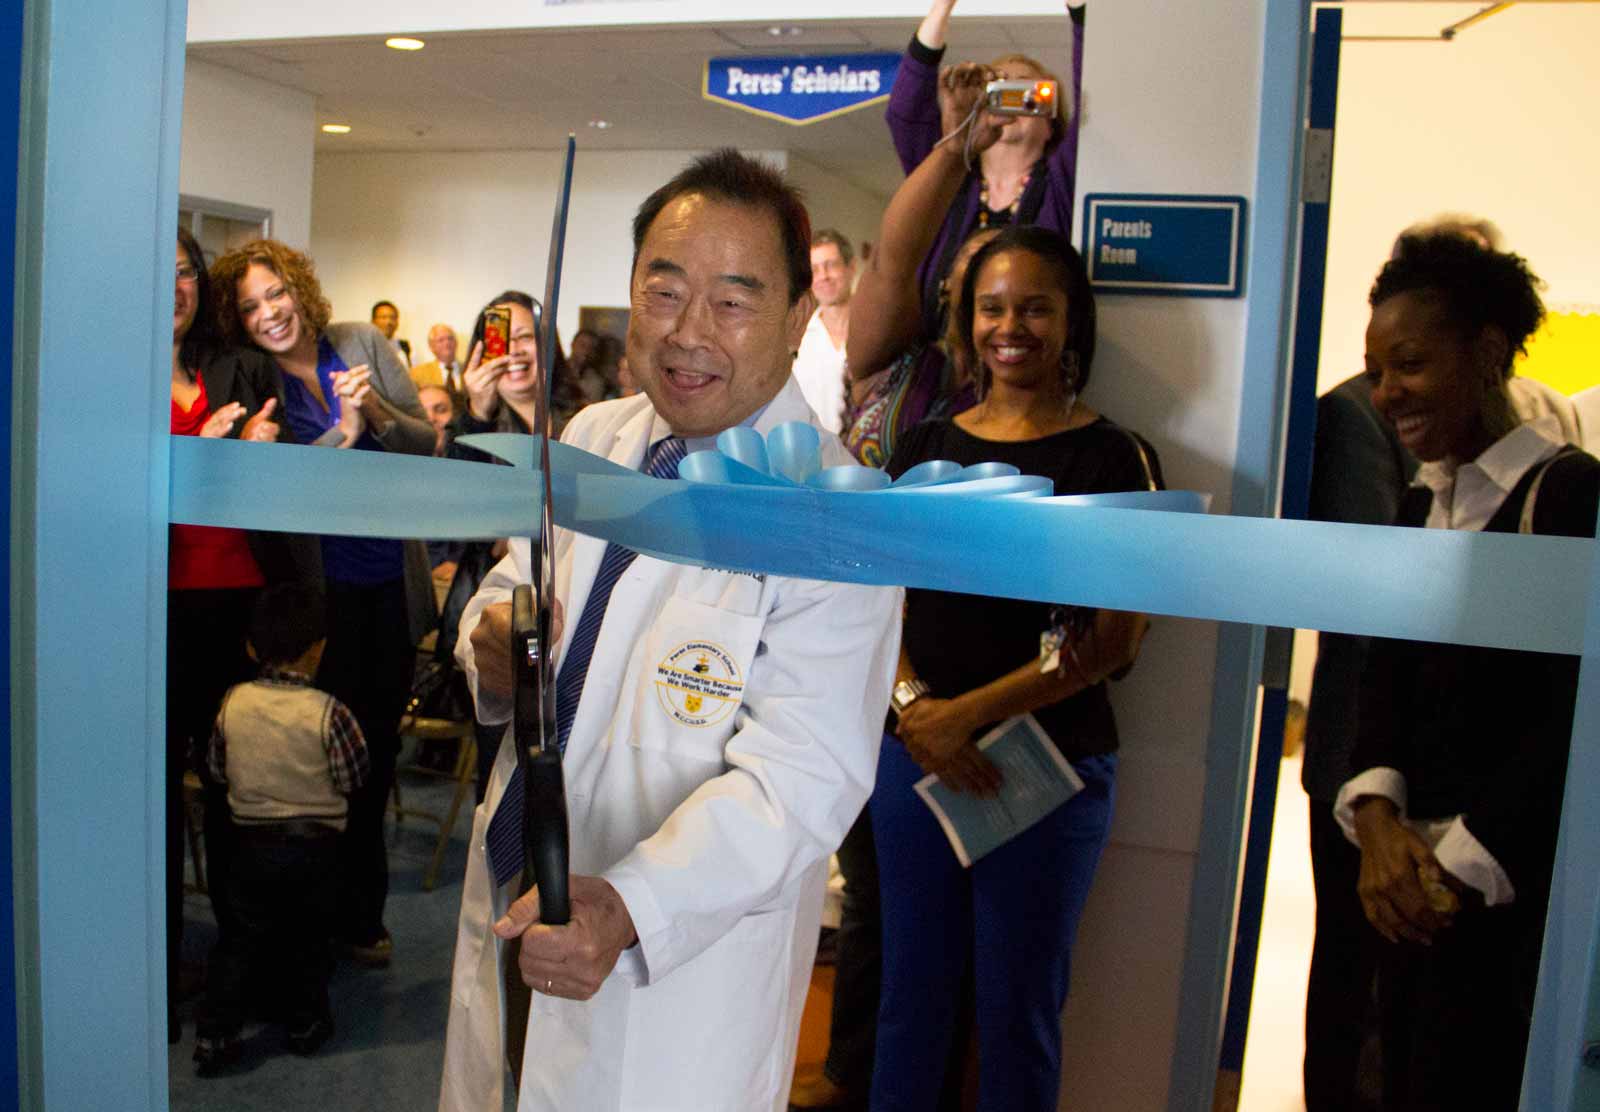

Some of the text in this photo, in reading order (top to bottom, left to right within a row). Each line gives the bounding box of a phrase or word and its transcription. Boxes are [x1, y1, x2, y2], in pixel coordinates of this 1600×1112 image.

[791, 65, 880, 93] Scholars
[1102, 218, 1152, 238] Parents
[1101, 245, 1137, 264] Room
[657, 667, 742, 692] We Are Smarter Because
[667, 677, 730, 698] We Work Harder
